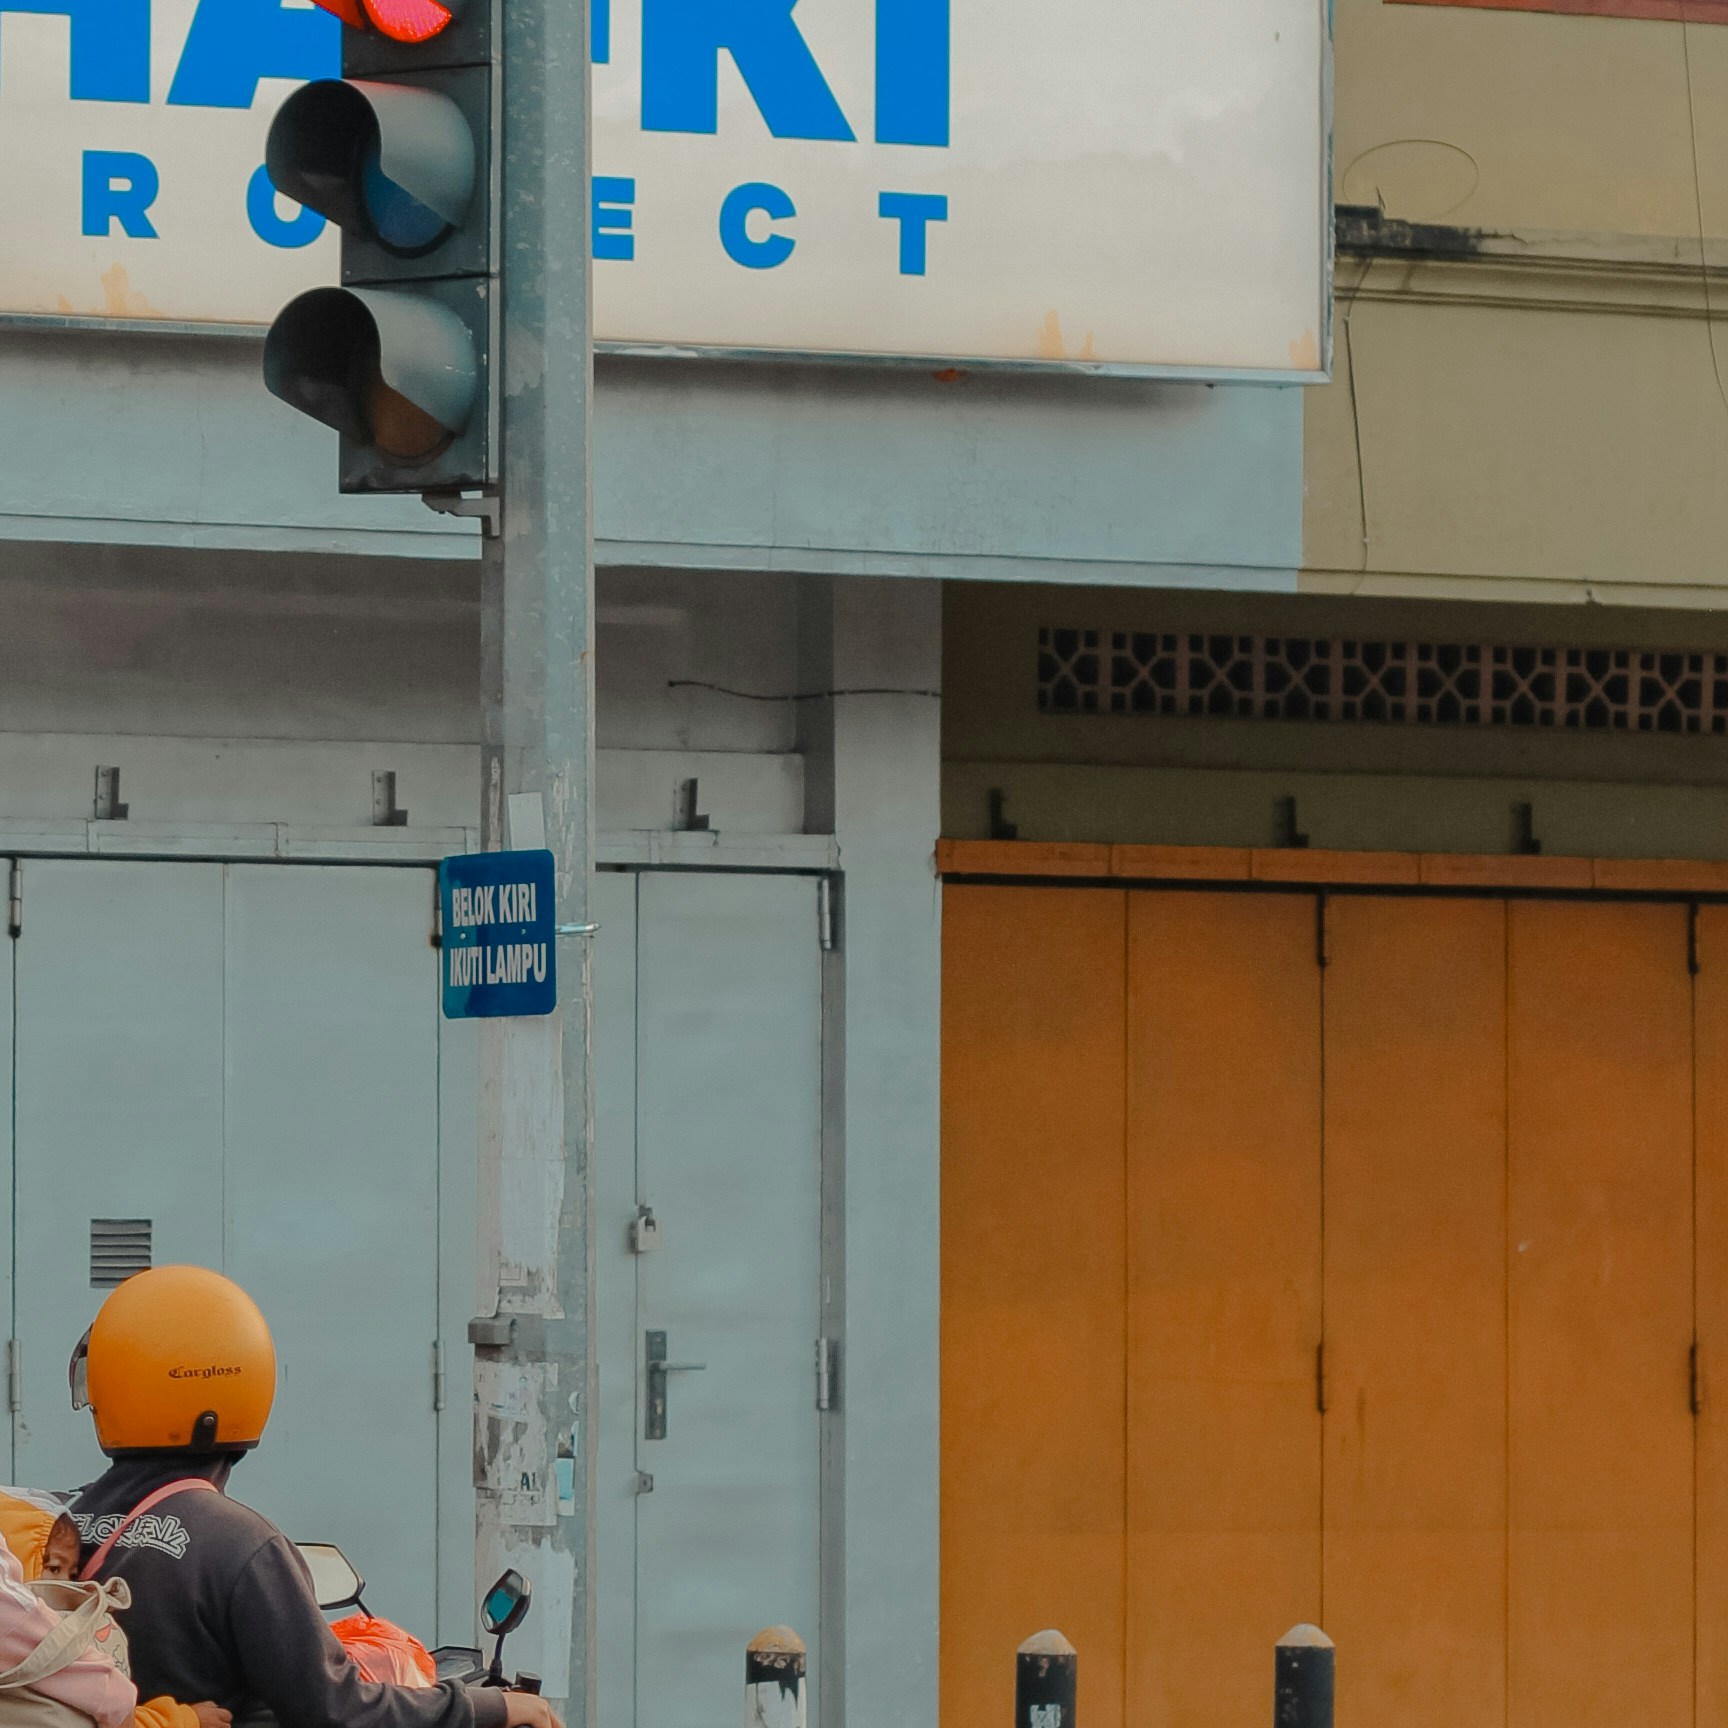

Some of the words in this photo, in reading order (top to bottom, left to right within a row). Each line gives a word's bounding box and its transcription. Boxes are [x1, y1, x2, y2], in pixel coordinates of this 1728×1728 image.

[452, 886, 495, 928] BELOK
[499, 883, 537, 923] KIRI
[450, 946, 483, 987] IKUTI
[486, 943, 547, 984] LAMPU
[168, 1365, 242, 1380] Cargloss
